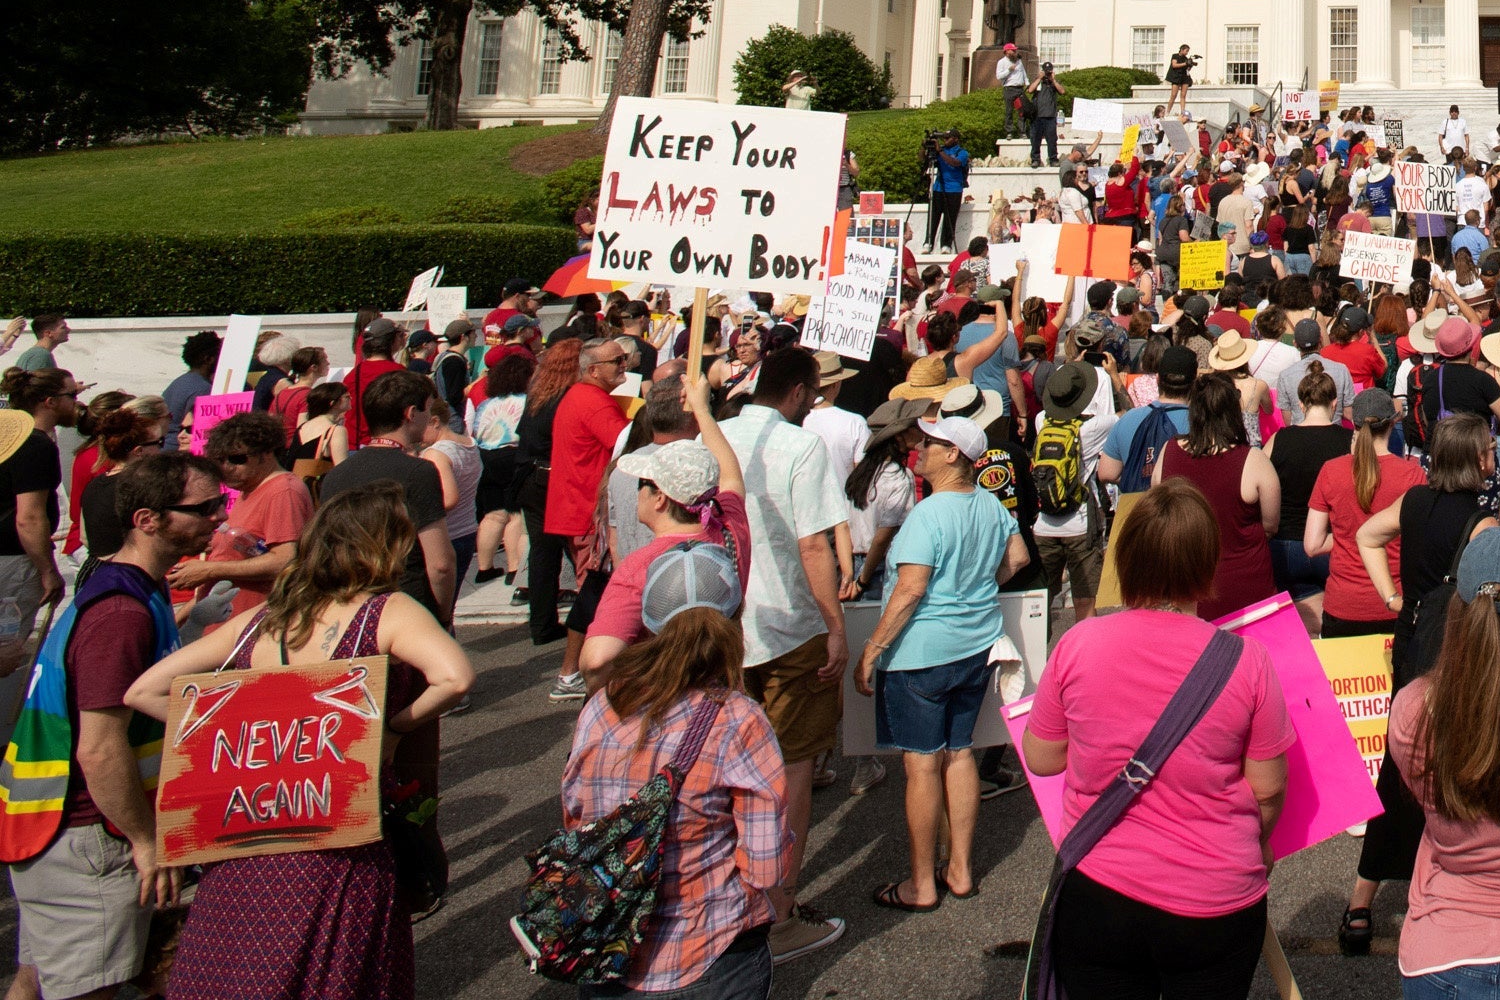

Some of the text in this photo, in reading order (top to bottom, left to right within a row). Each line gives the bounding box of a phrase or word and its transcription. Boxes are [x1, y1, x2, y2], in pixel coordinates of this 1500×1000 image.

[1286, 93, 1304, 103] NOT
[629, 114, 797, 170] KEEP YOUR
[1397, 163, 1456, 189] YOUR BODY
[604, 171, 776, 222] LAWS TO
[1396, 187, 1426, 211] YOUR
[1425, 187, 1456, 212] CHOICE
[597, 225, 830, 281] YOUR OWN BODY!
[844, 253, 881, 269] ABAMA
[1350, 260, 1399, 283] CHOOSE
[827, 281, 855, 300] ROUD
[991, 453, 1011, 463] RUN
[1329, 674, 1388, 696] ORTION
[1339, 697, 1391, 719] ALTHCA
[211, 711, 347, 773] NEVER
[221, 772, 333, 828] AGAIN
